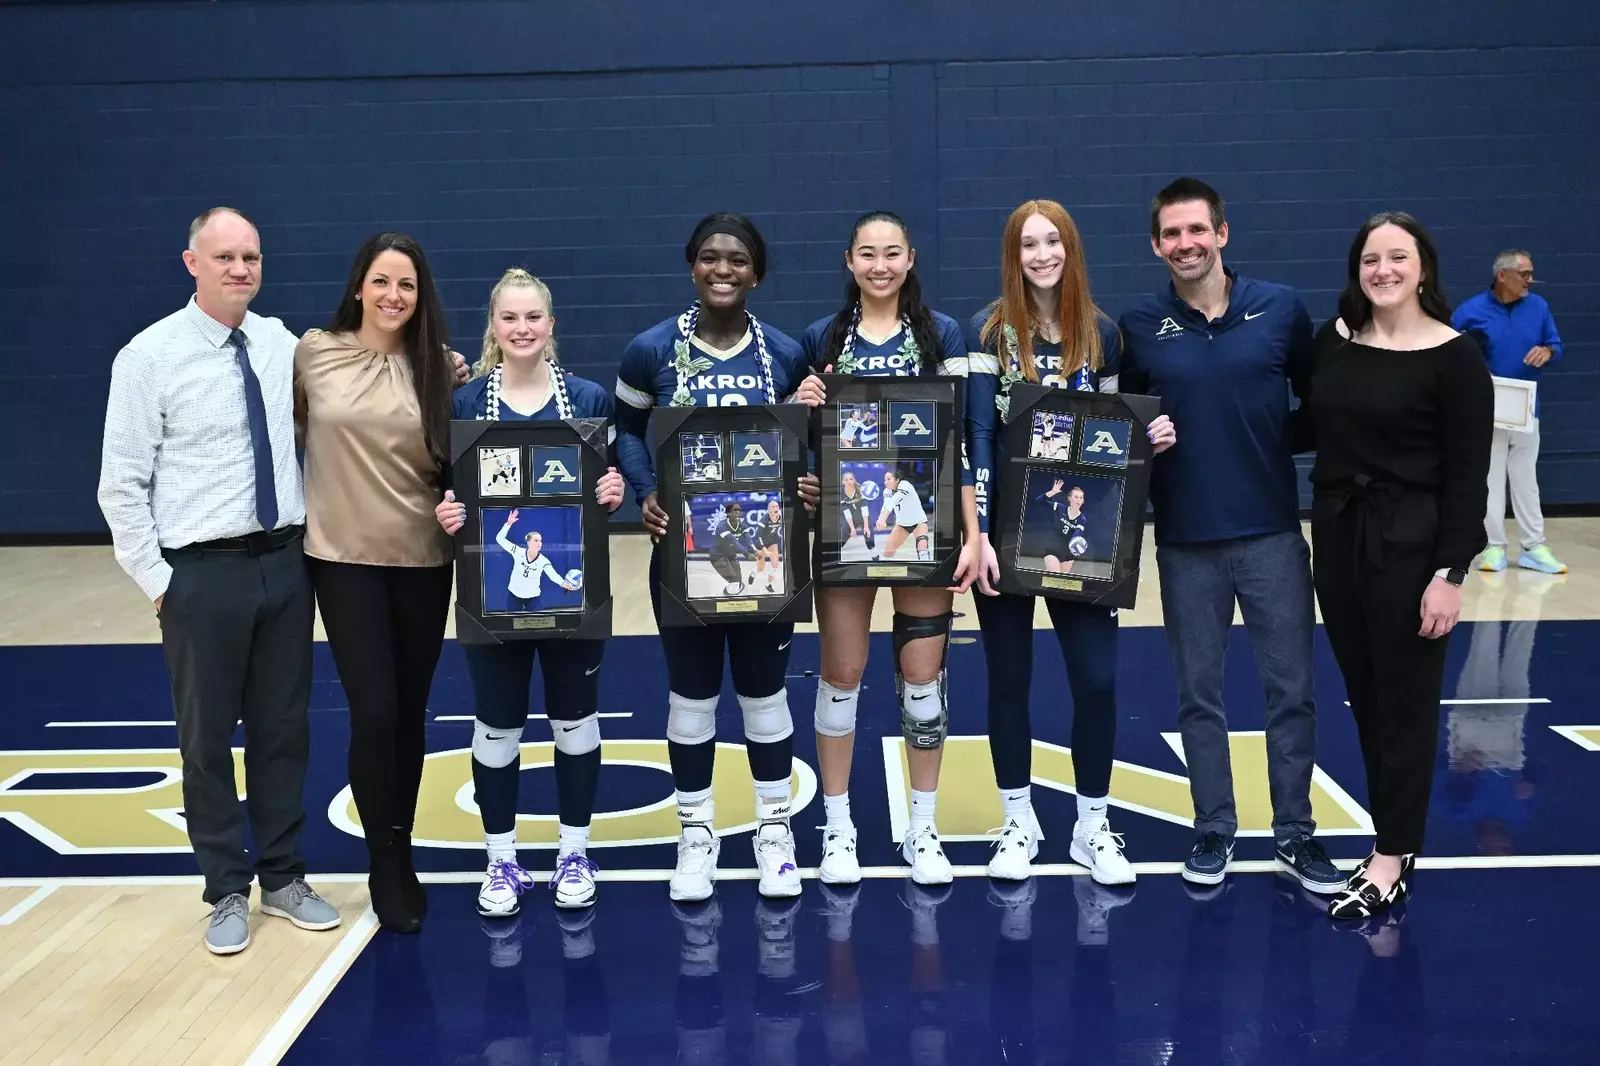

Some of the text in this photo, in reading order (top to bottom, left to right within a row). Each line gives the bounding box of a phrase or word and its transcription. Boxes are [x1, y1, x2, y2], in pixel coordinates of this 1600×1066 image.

[1156, 317, 1184, 336] A
[854, 354, 906, 371] KRO
[893, 413, 932, 435] A
[1085, 430, 1124, 455] A
[737, 444, 776, 467] A
[537, 460, 577, 483] A
[976, 468, 990, 517] ZIPS
